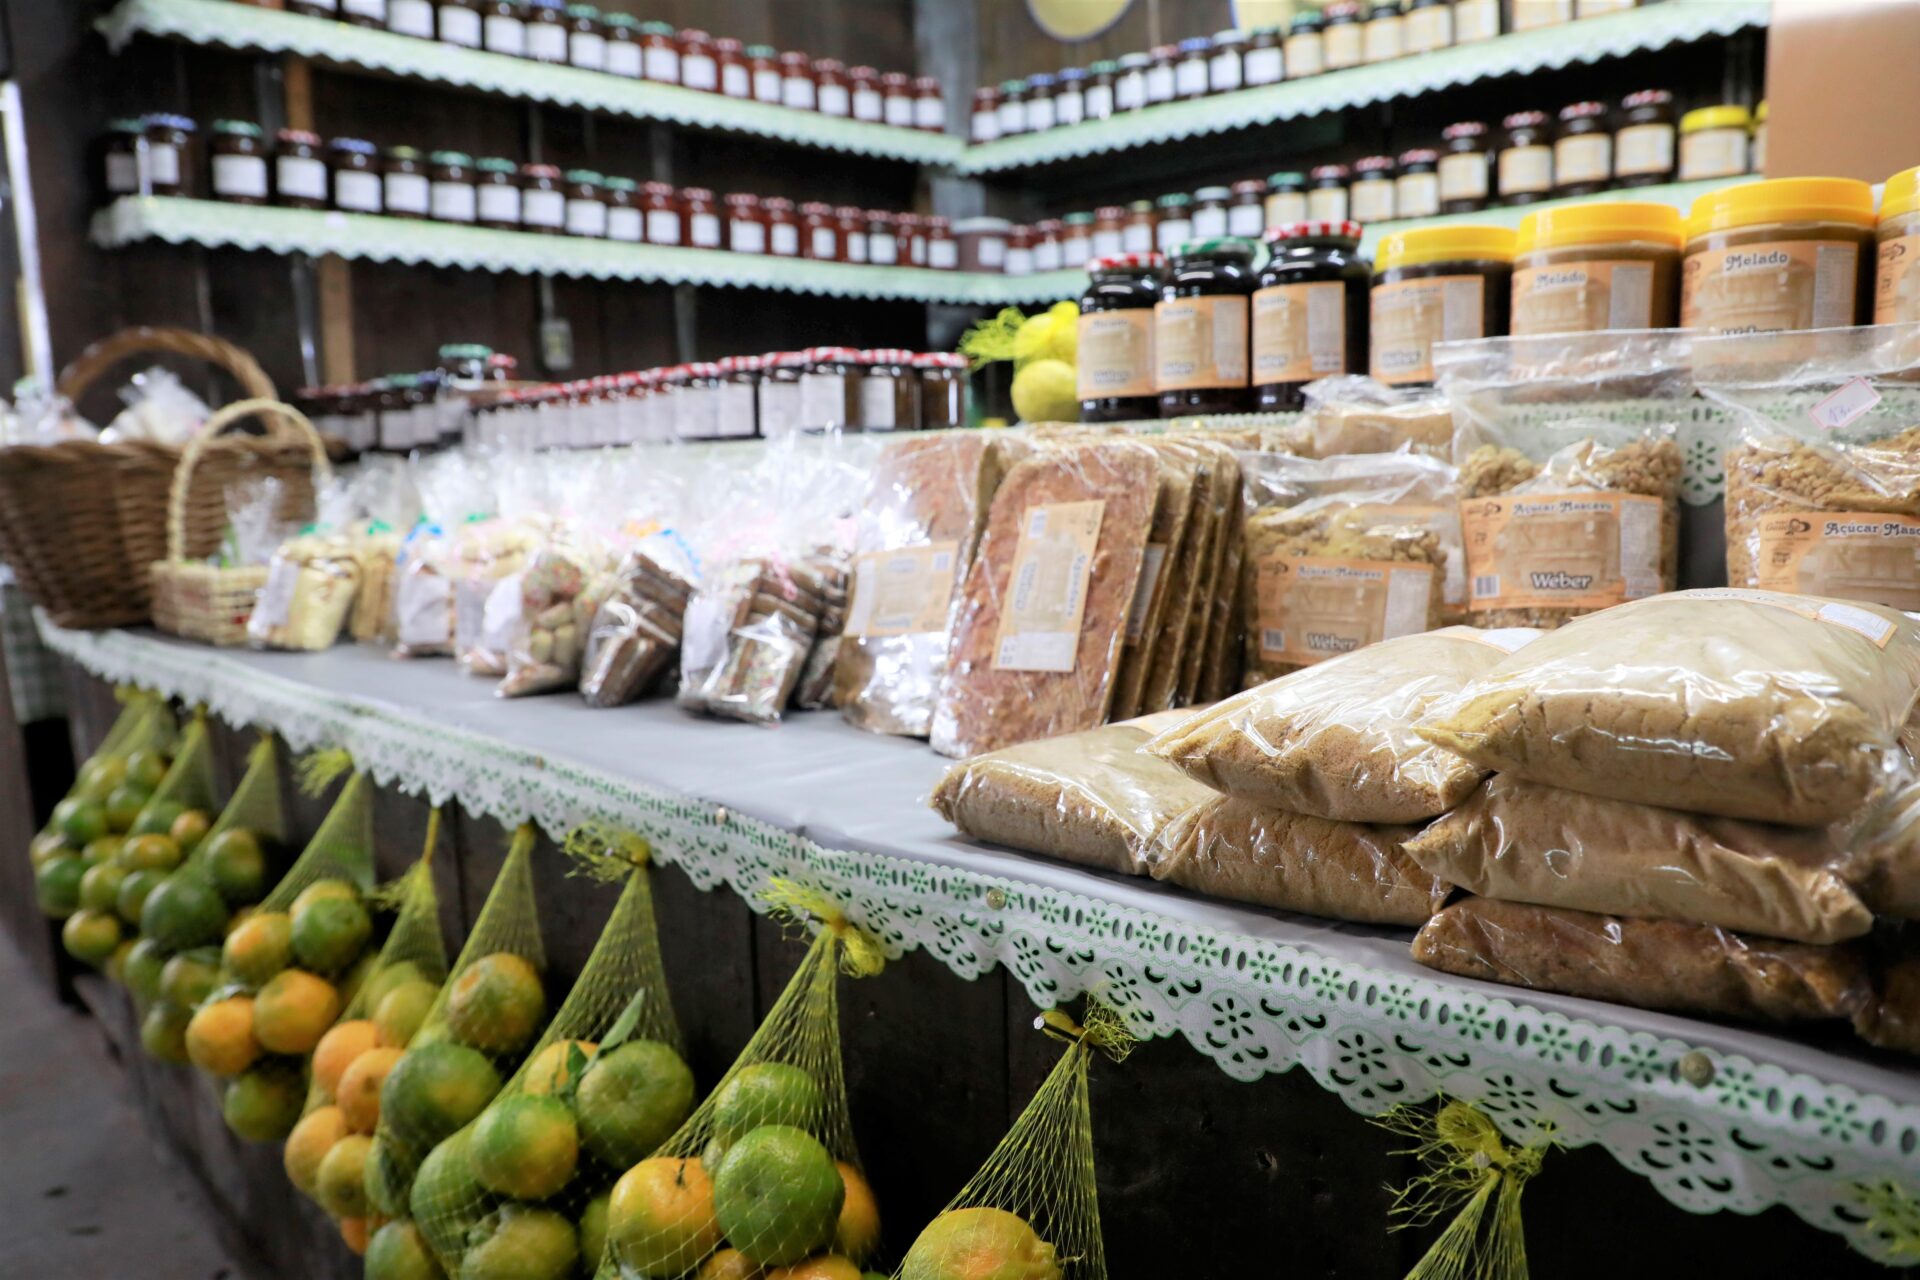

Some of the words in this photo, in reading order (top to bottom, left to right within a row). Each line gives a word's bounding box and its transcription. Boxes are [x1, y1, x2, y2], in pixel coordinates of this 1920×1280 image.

[1725, 250, 1788, 271] Melado
[1824, 521, 1879, 536] Açúcar
[1530, 571, 1593, 590] Weber
[1306, 632, 1359, 653] Weber
